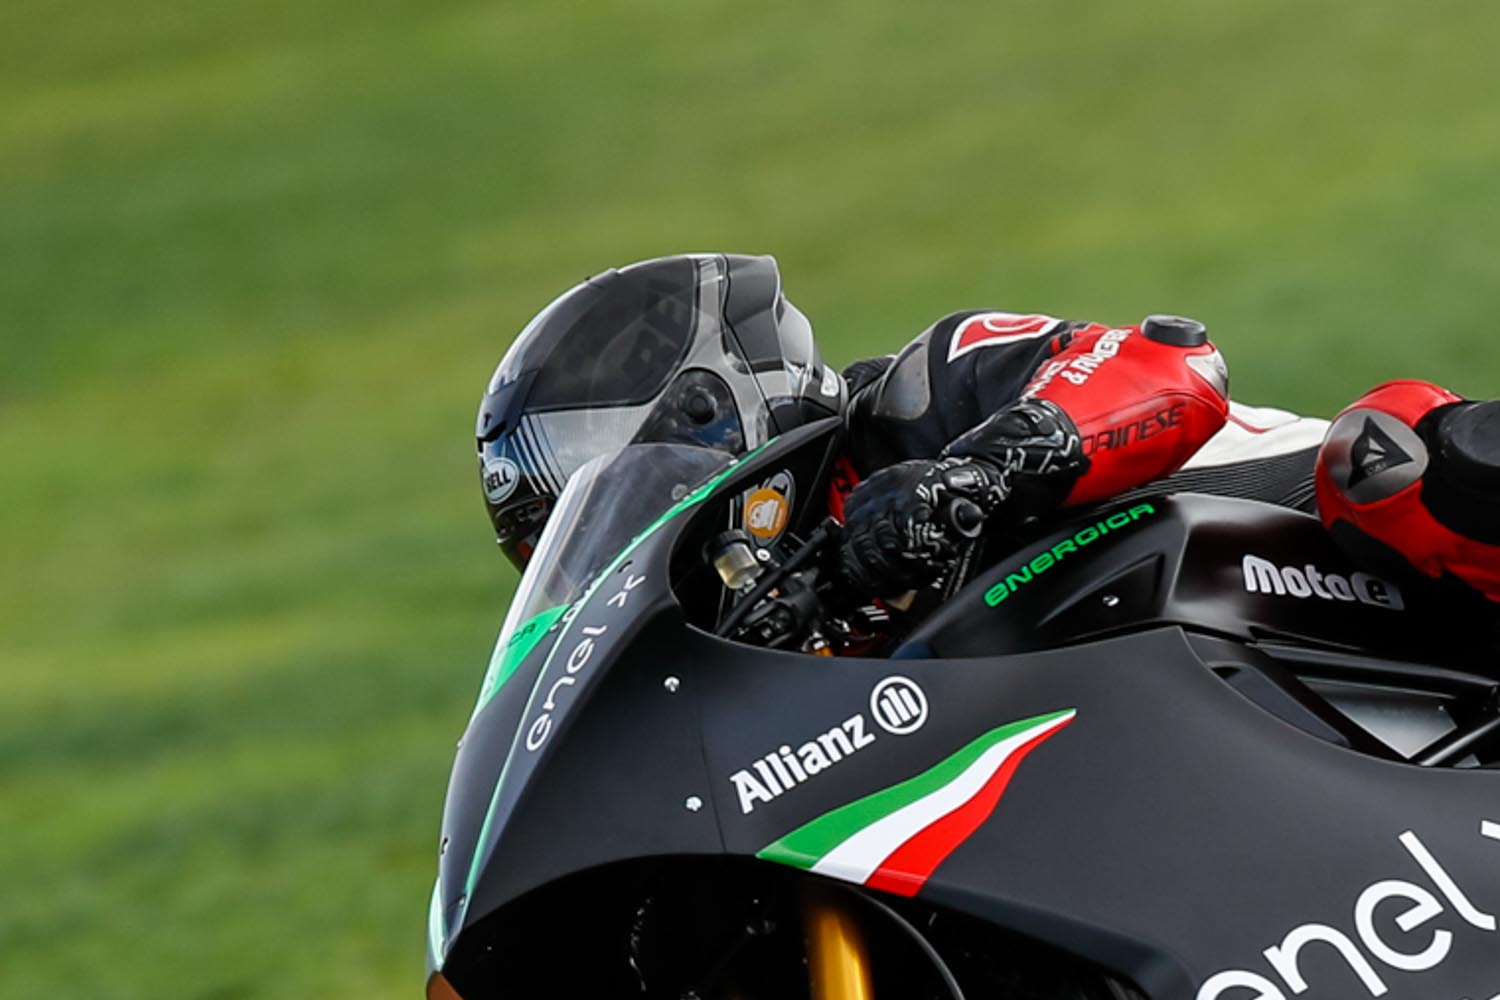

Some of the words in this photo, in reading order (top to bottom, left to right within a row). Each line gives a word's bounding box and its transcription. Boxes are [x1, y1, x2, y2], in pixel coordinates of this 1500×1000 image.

[486, 467, 512, 493] BELL
[526, 624, 607, 751] enel
[729, 714, 876, 814] Allianz
